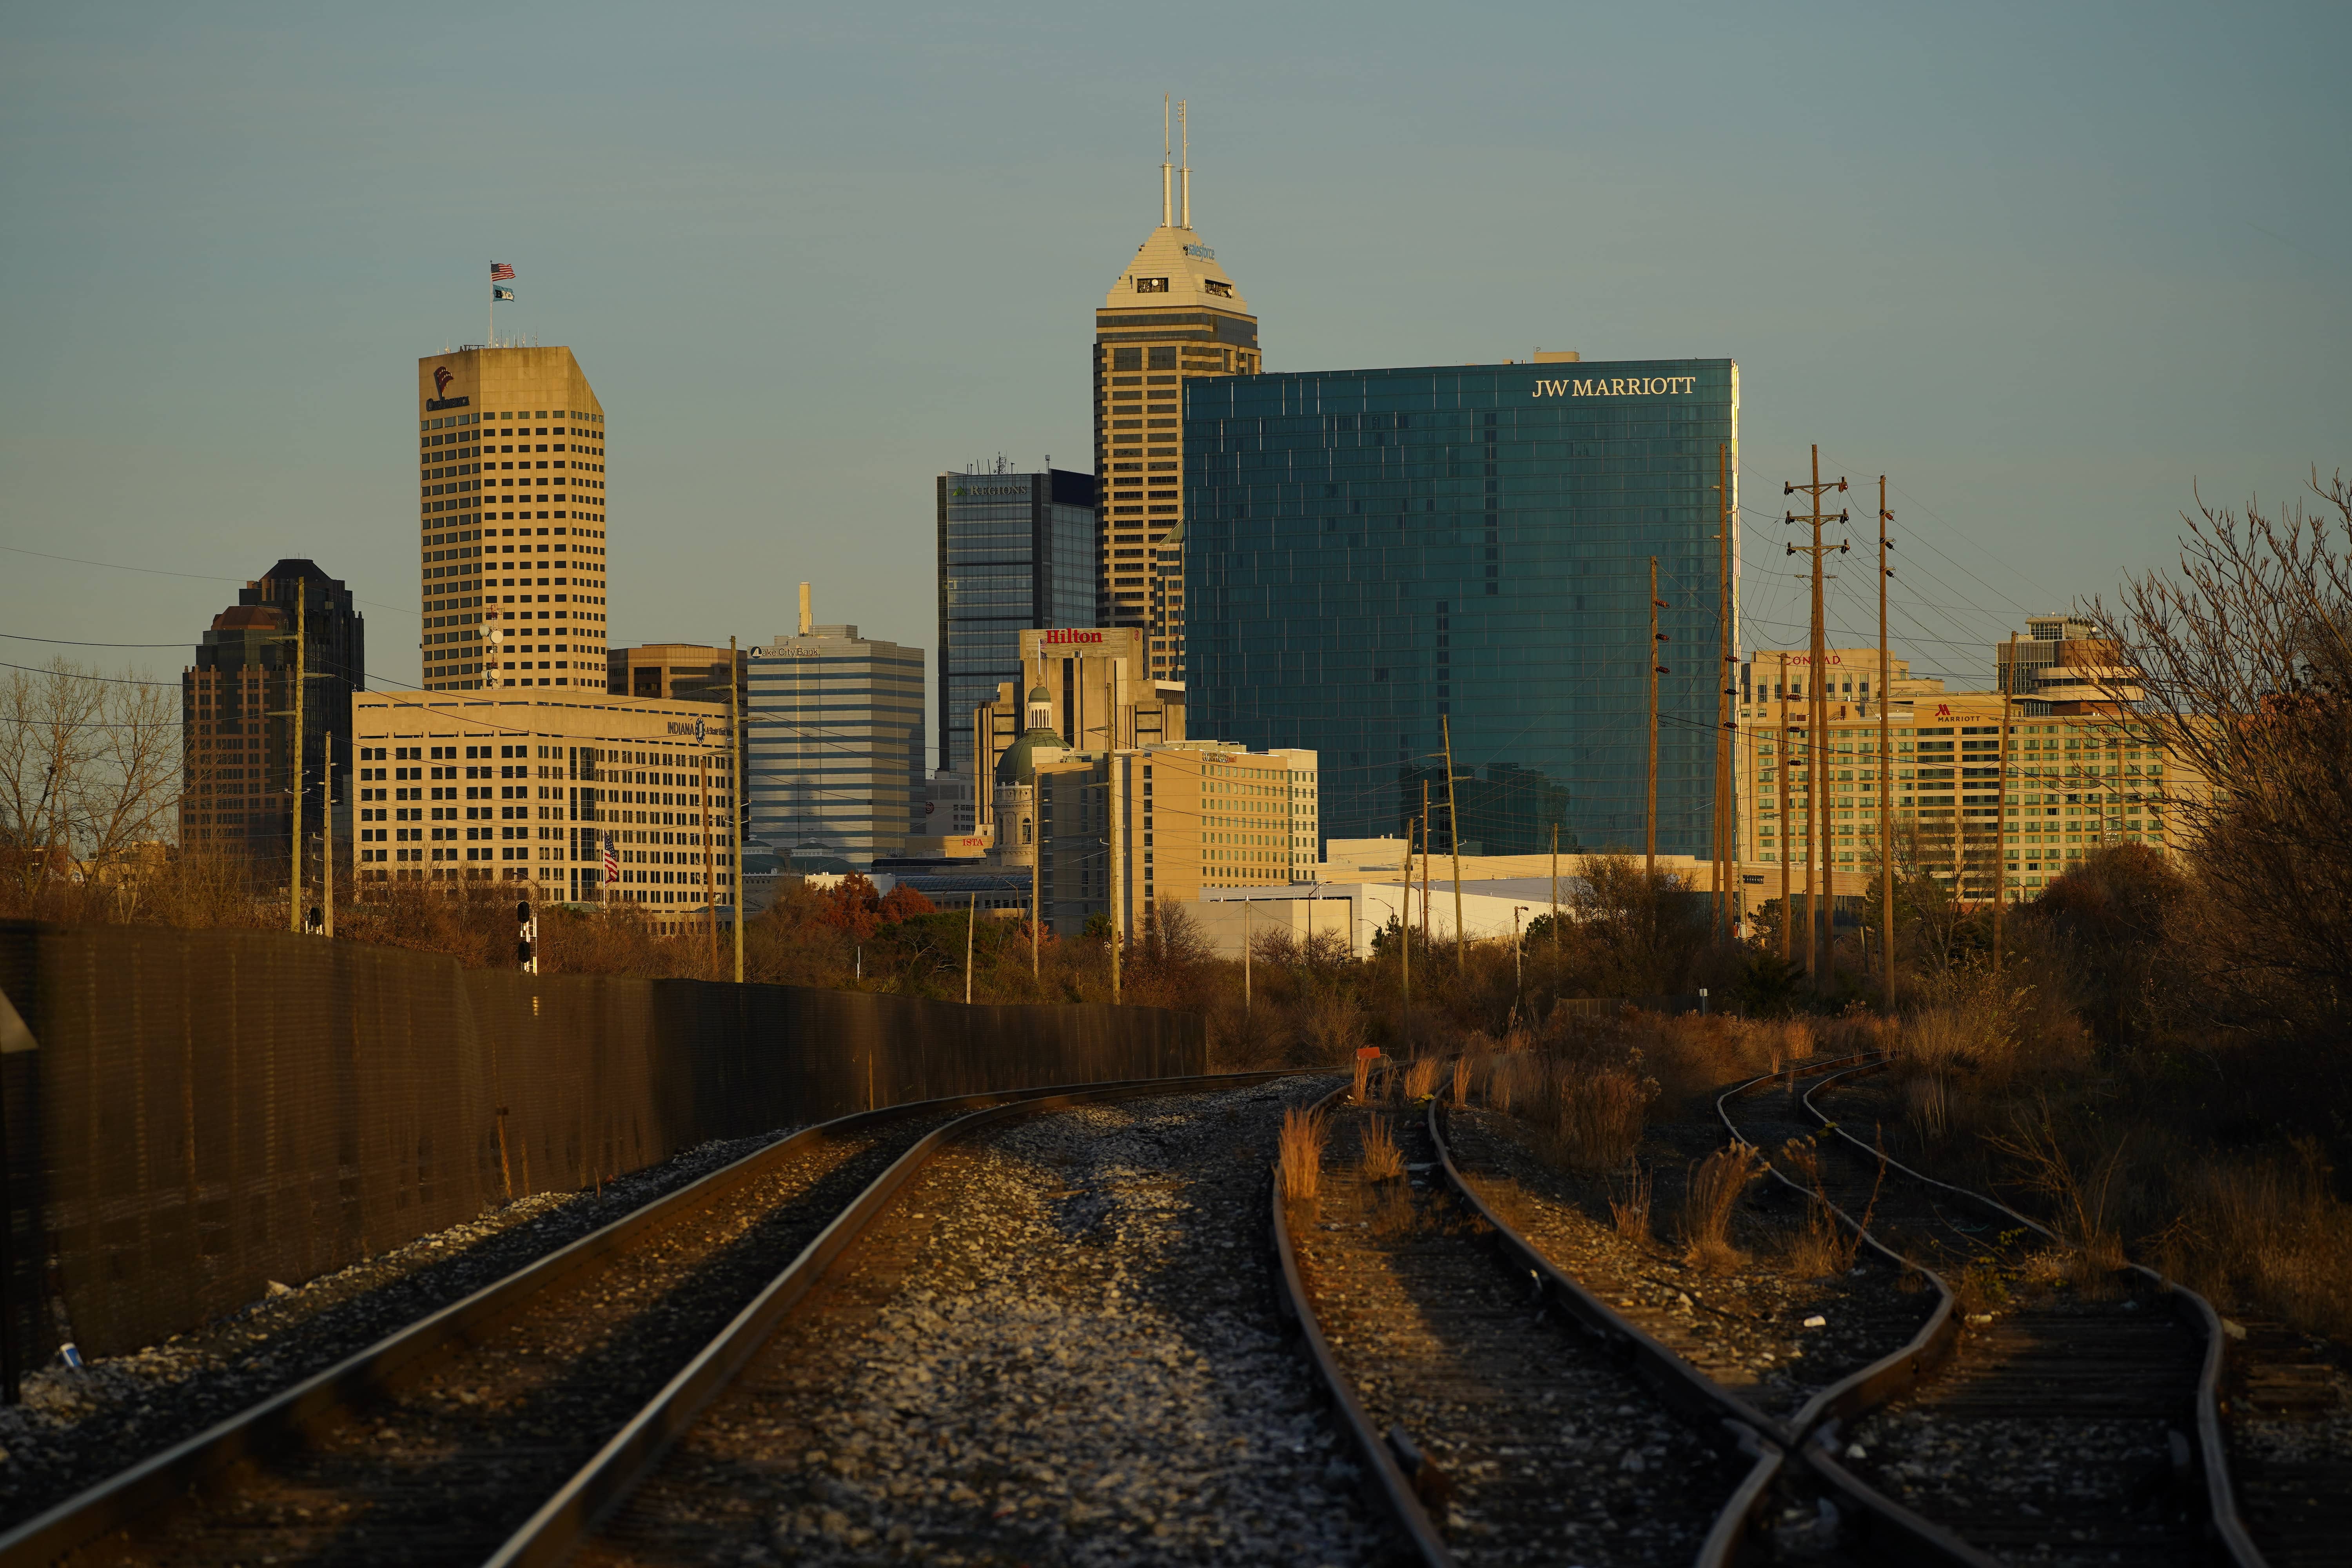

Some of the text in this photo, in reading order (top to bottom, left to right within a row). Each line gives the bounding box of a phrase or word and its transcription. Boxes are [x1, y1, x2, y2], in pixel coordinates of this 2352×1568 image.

[1188, 241, 1215, 261] salesforce
[1532, 376, 1696, 397] JW MARRIOTT
[1046, 628, 1103, 644] Hilton
[779, 648, 797, 658] City
[797, 648, 818, 656] Bank
[668, 721, 695, 735] INDIANA
